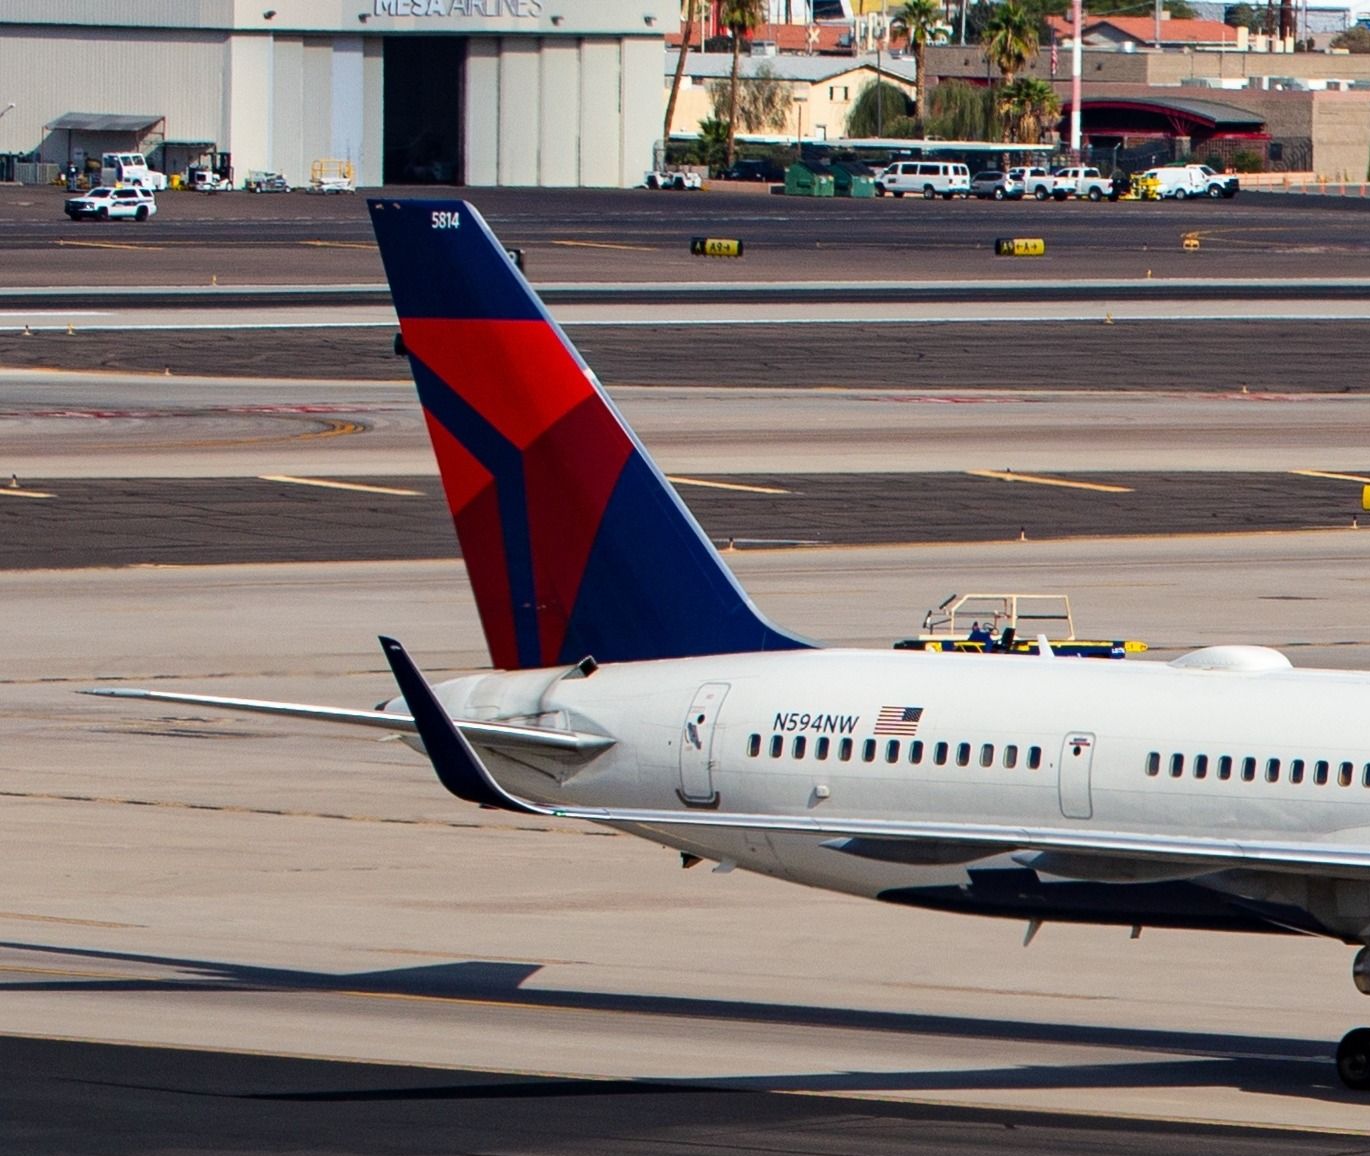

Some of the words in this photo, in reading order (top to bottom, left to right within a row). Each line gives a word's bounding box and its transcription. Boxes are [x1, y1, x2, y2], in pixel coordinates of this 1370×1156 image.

[374, 0, 446, 16] MESA
[448, 0, 543, 17] AIRLINES
[431, 211, 460, 229] 5814
[773, 712, 860, 734] N594NW
